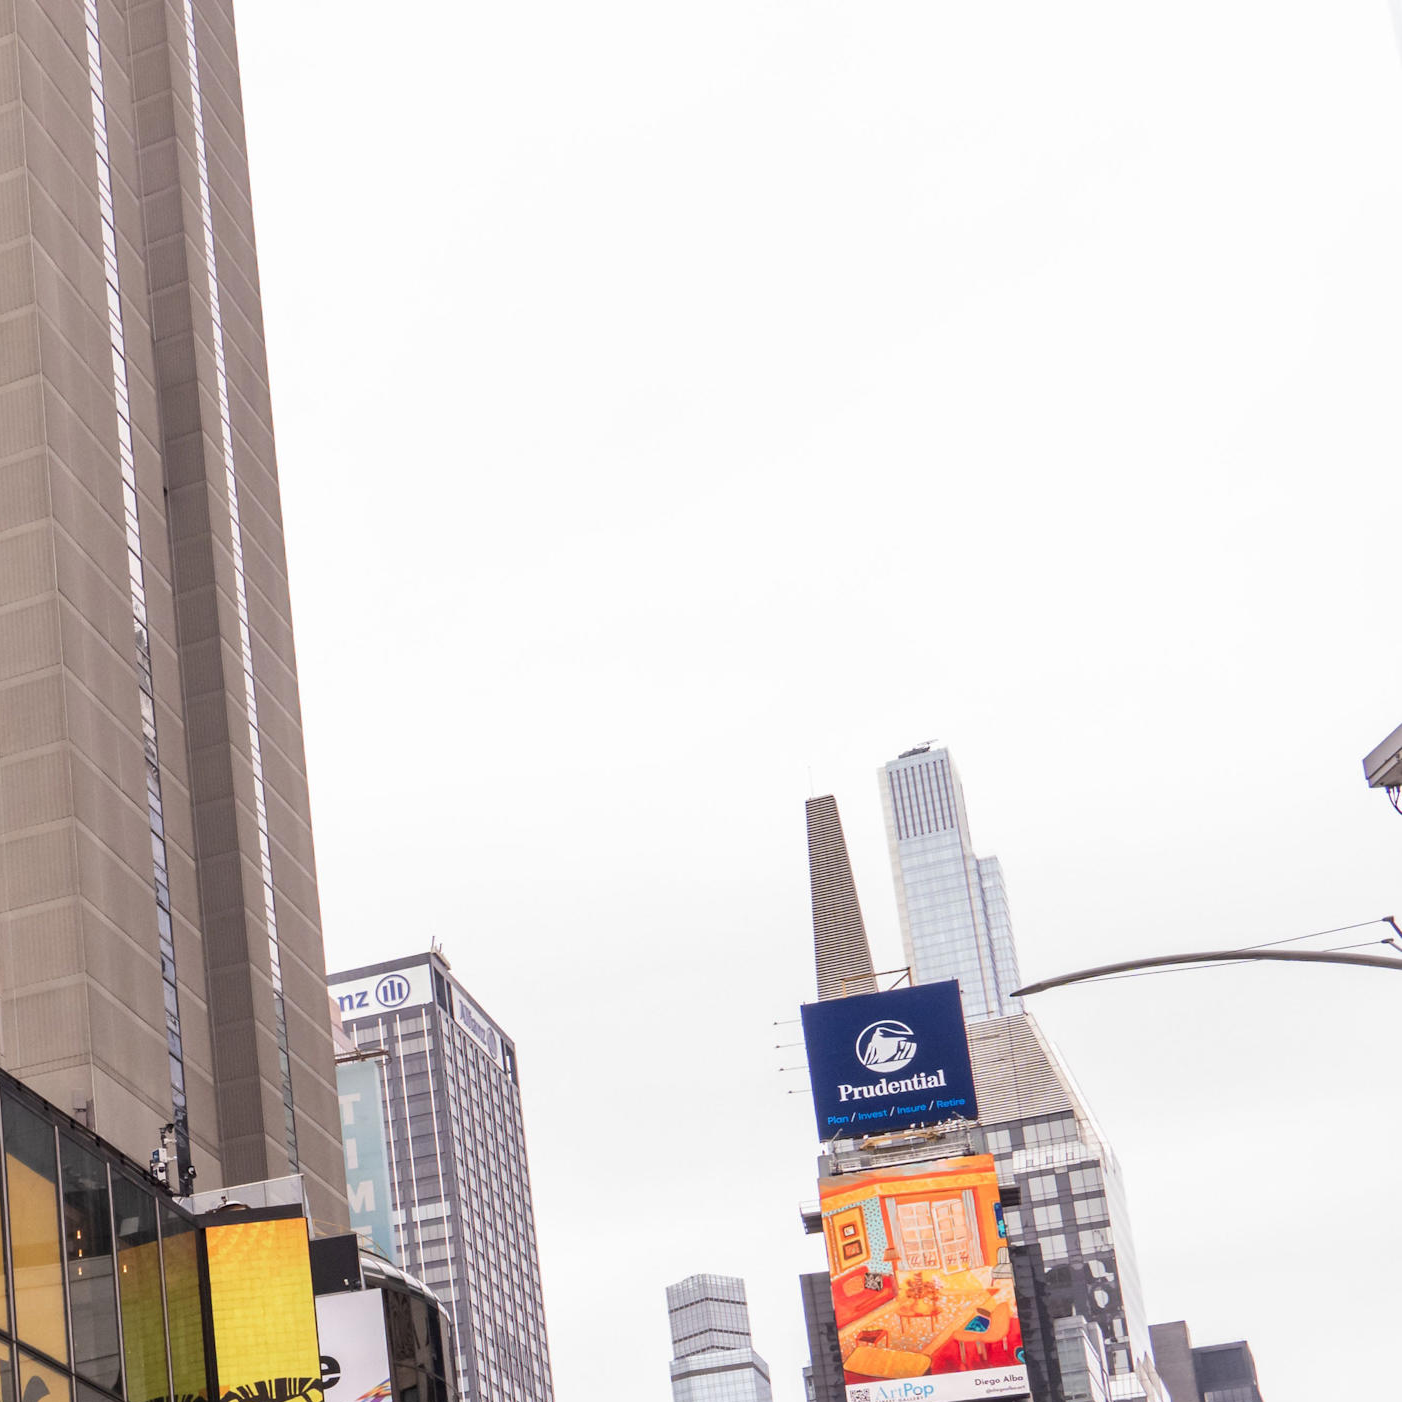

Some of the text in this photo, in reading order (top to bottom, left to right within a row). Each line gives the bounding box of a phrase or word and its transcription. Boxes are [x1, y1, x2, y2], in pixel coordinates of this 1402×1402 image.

[838, 1069, 946, 1102] Prudential
[827, 1097, 966, 1126] Plan Invest Insure Retire
[876, 1383, 934, 1399] ArtPop
[974, 1378, 1001, 1386] Diego
